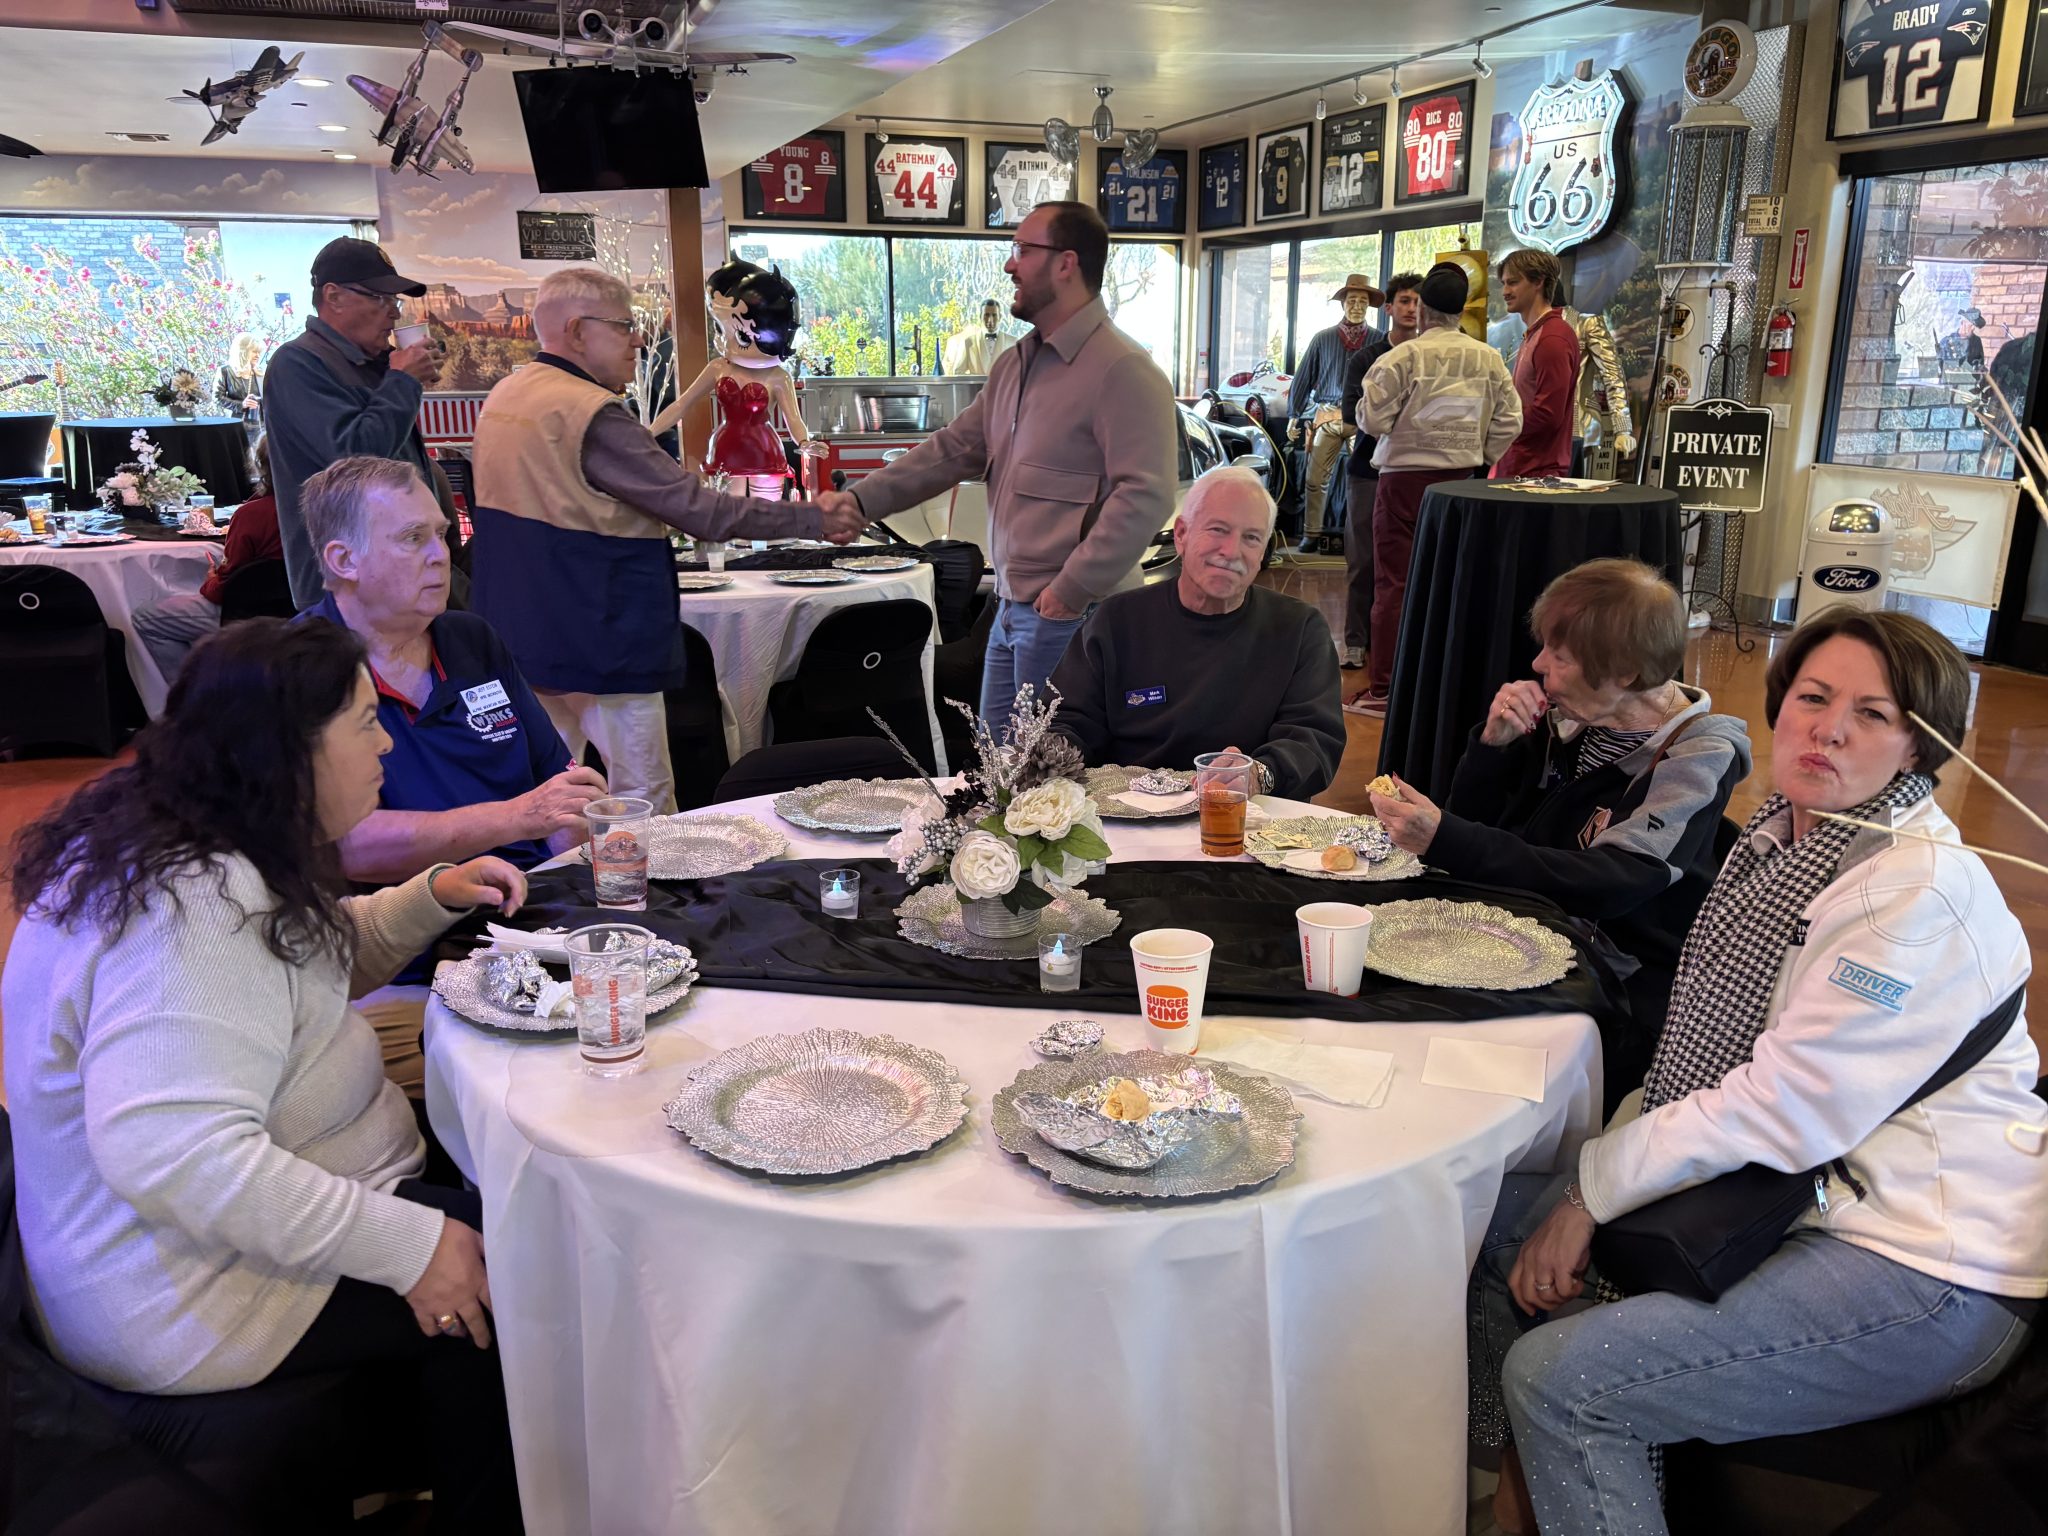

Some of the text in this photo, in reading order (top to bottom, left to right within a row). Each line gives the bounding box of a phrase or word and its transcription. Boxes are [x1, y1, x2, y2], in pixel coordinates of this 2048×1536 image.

[1892, 3, 1940, 31] BRADY
[1875, 37, 1944, 116] 12
[1406, 117, 1421, 137] 80
[1425, 110, 1442, 126] RICE
[1448, 111, 1463, 128] 80
[780, 145, 810, 158] YOUNG
[820, 151, 830, 165] 8
[896, 152, 936, 165] RATHMAN
[1416, 129, 1449, 182] 80
[1553, 142, 1578, 160] US
[876, 158, 897, 173] 44
[937, 162, 956, 177] 44
[996, 164, 1018, 180] 44
[1018, 160, 1048, 172] RATHMAN
[1050, 166, 1070, 182] 44
[783, 163, 805, 204] 8
[1338, 152, 1364, 198] 12
[893, 170, 938, 209] 44
[1108, 182, 1121, 195] 21
[1163, 185, 1175, 199] 21
[1215, 176, 1229, 208] 12
[1276, 166, 1289, 205] 9
[1525, 156, 1594, 230] 66
[1012, 178, 1050, 217] 44
[1126, 185, 1159, 223] 21
[1769, 196, 1780, 206] 10
[1772, 206, 1779, 216] 6
[1767, 217, 1778, 227] 16
[522, 228, 542, 241] VIP
[1671, 432, 1762, 457] PRIVATE
[1598, 451, 1610, 459] AND
[1677, 465, 1750, 489] EVENT
[1824, 568, 1870, 589] Ford
[472, 707, 515, 727] WERKS
[1303, 935, 1313, 984] BURGER KING
[1840, 964, 1904, 1000] DRIVER
[1146, 994, 1189, 1009] BURGER
[608, 979, 621, 1046] BURGER KING
[1147, 1004, 1189, 1021] KING
